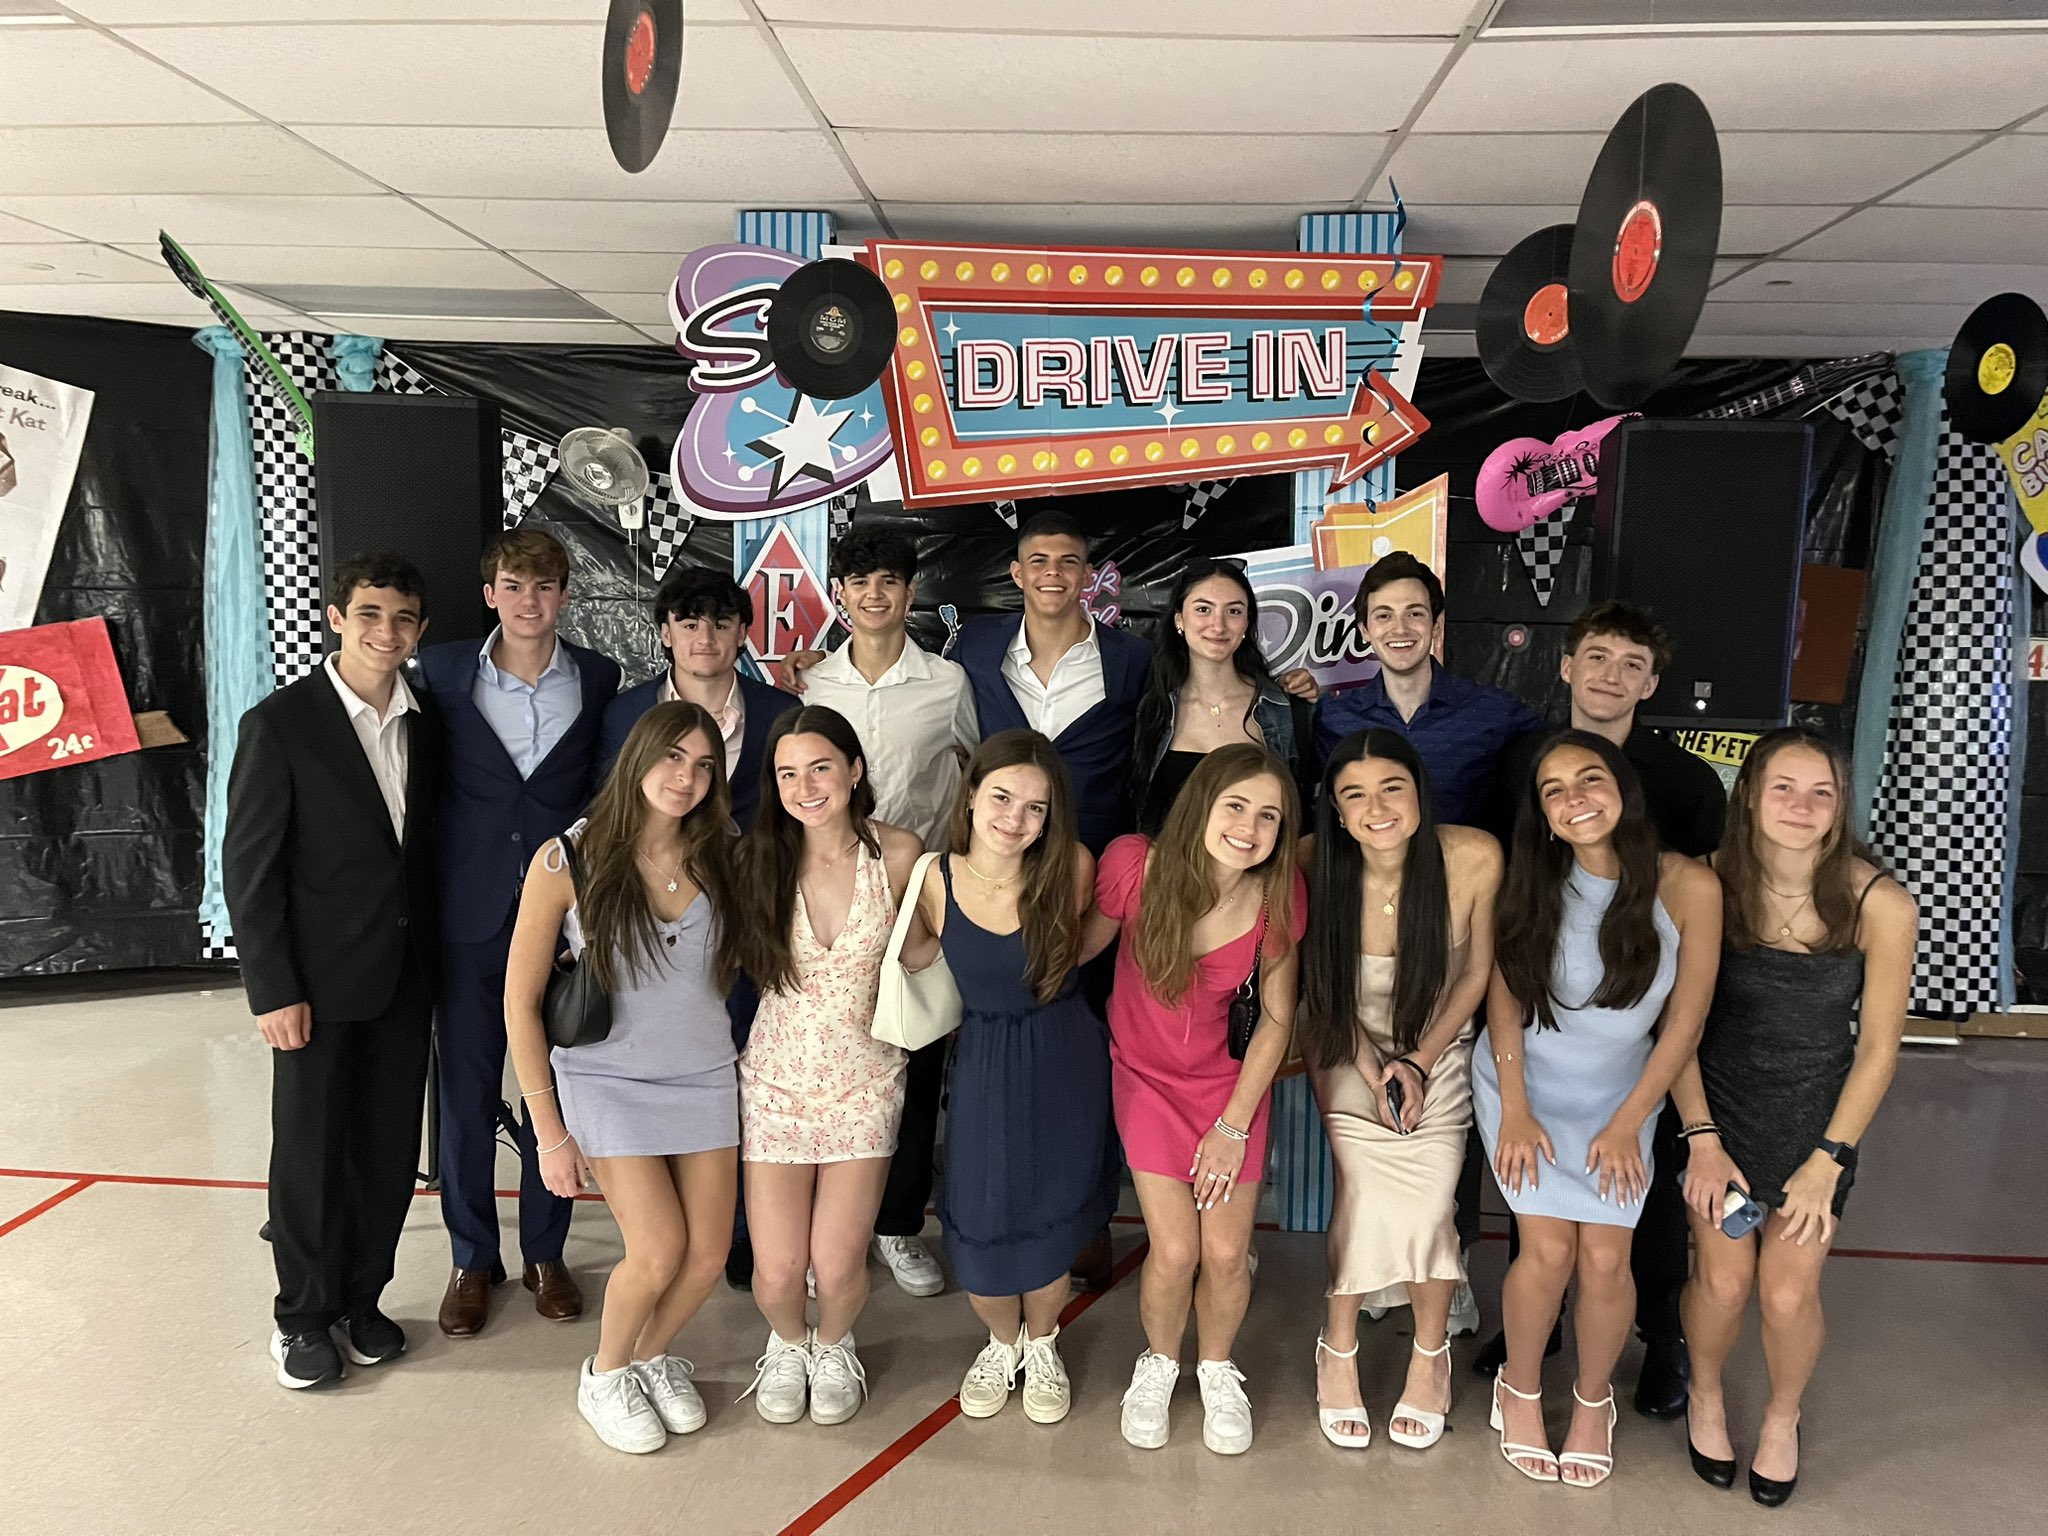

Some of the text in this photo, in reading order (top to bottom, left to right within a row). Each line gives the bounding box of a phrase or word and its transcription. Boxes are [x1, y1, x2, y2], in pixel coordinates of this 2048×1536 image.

[0, 386, 56, 410] eak...
[955, 326, 1348, 410] DRIVE IN
[9, 407, 47, 431] Kat
[757, 568, 804, 662] E
[1254, 584, 1377, 677] Din
[0, 669, 46, 750] at
